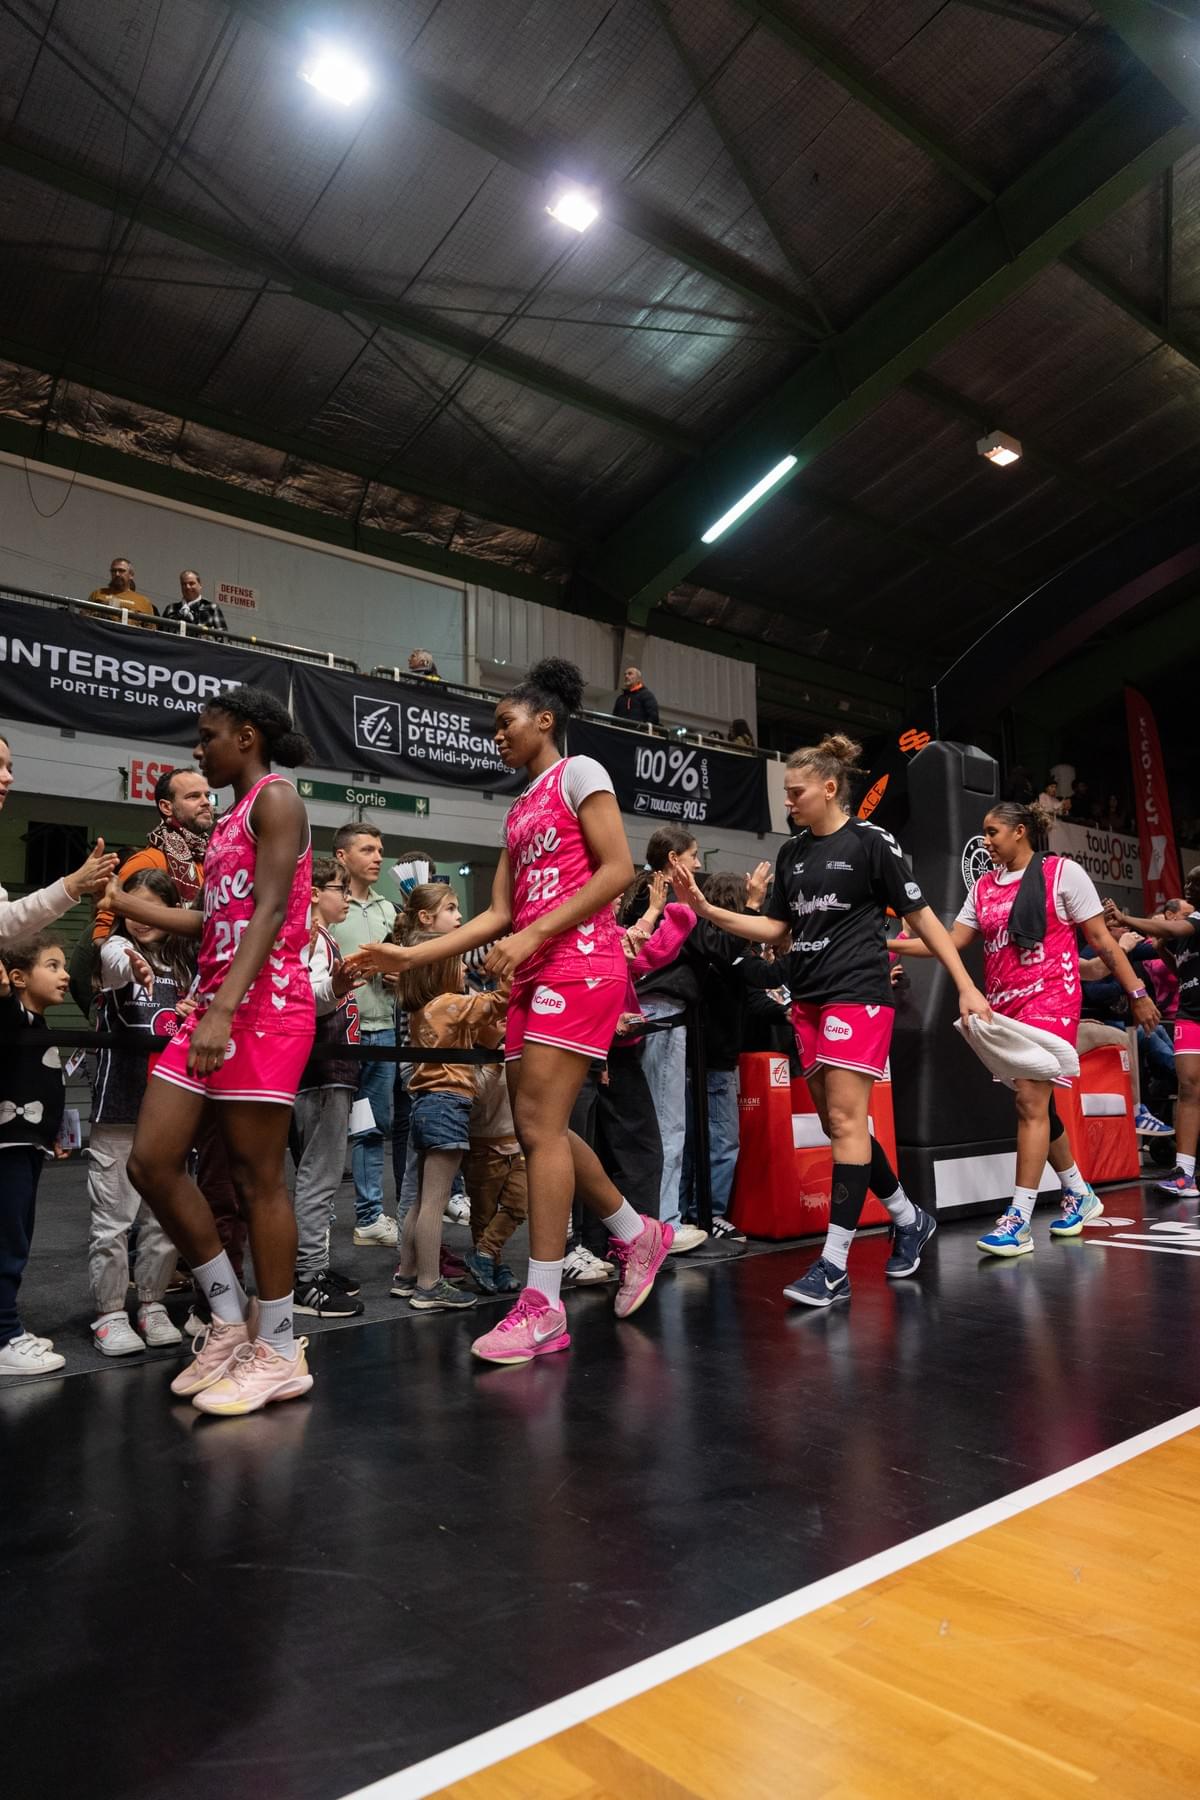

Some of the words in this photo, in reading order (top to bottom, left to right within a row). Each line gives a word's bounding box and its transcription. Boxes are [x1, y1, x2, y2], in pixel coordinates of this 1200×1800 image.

[218, 593, 228, 603] DE
[230, 596, 256, 608] FUMER
[221, 584, 254, 598] DEFENSE
[50, 676, 120, 700] PORTET
[124, 690, 159, 707] SUR
[163, 697, 207, 714] GARO
[407, 706, 471, 733] CAISSE
[408, 744, 426, 758] de
[429, 749, 517, 775] Midi-Pyrénées
[636, 750, 697, 791] 100%
[345, 788, 387, 807] Sortie
[650, 798, 682, 814] TOULOUSE
[683, 801, 707, 821] 90.5
[1086, 829, 1140, 861] toulous
[526, 867, 560, 902] 22
[1020, 941, 1044, 966] 23
